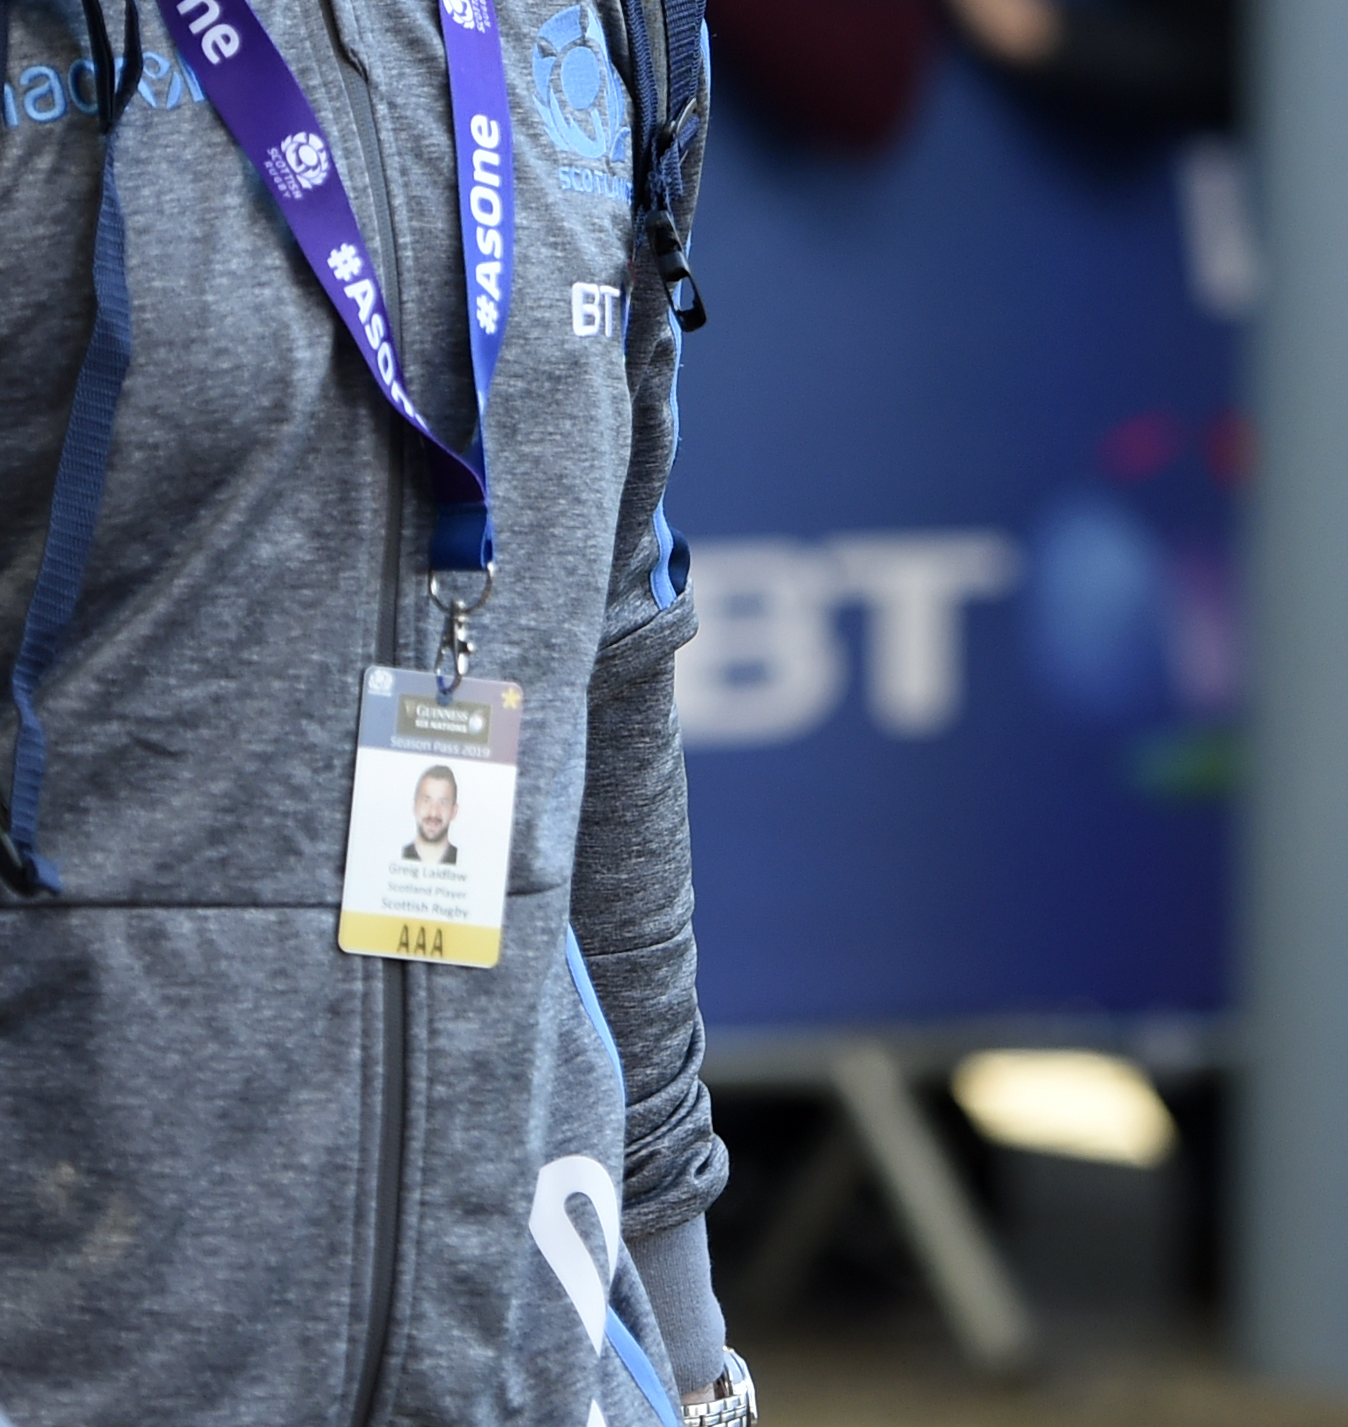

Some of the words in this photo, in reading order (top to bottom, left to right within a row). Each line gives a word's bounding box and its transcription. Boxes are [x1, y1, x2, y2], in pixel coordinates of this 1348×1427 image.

[266, 147, 303, 199] SCOTTISH
[469, 113, 502, 336] #AsOne
[571, 281, 621, 339] BT
[326, 242, 429, 433] #AsOn
[416, 704, 469, 722] GUINNESS
[430, 721, 468, 734] NATIONS
[390, 735, 432, 751] Season
[433, 741, 459, 755] Pass
[461, 744, 491, 758] 2019
[388, 863, 419, 879] Greig
[381, 896, 428, 912] Scottish
[431, 901, 469, 920] Rugby
